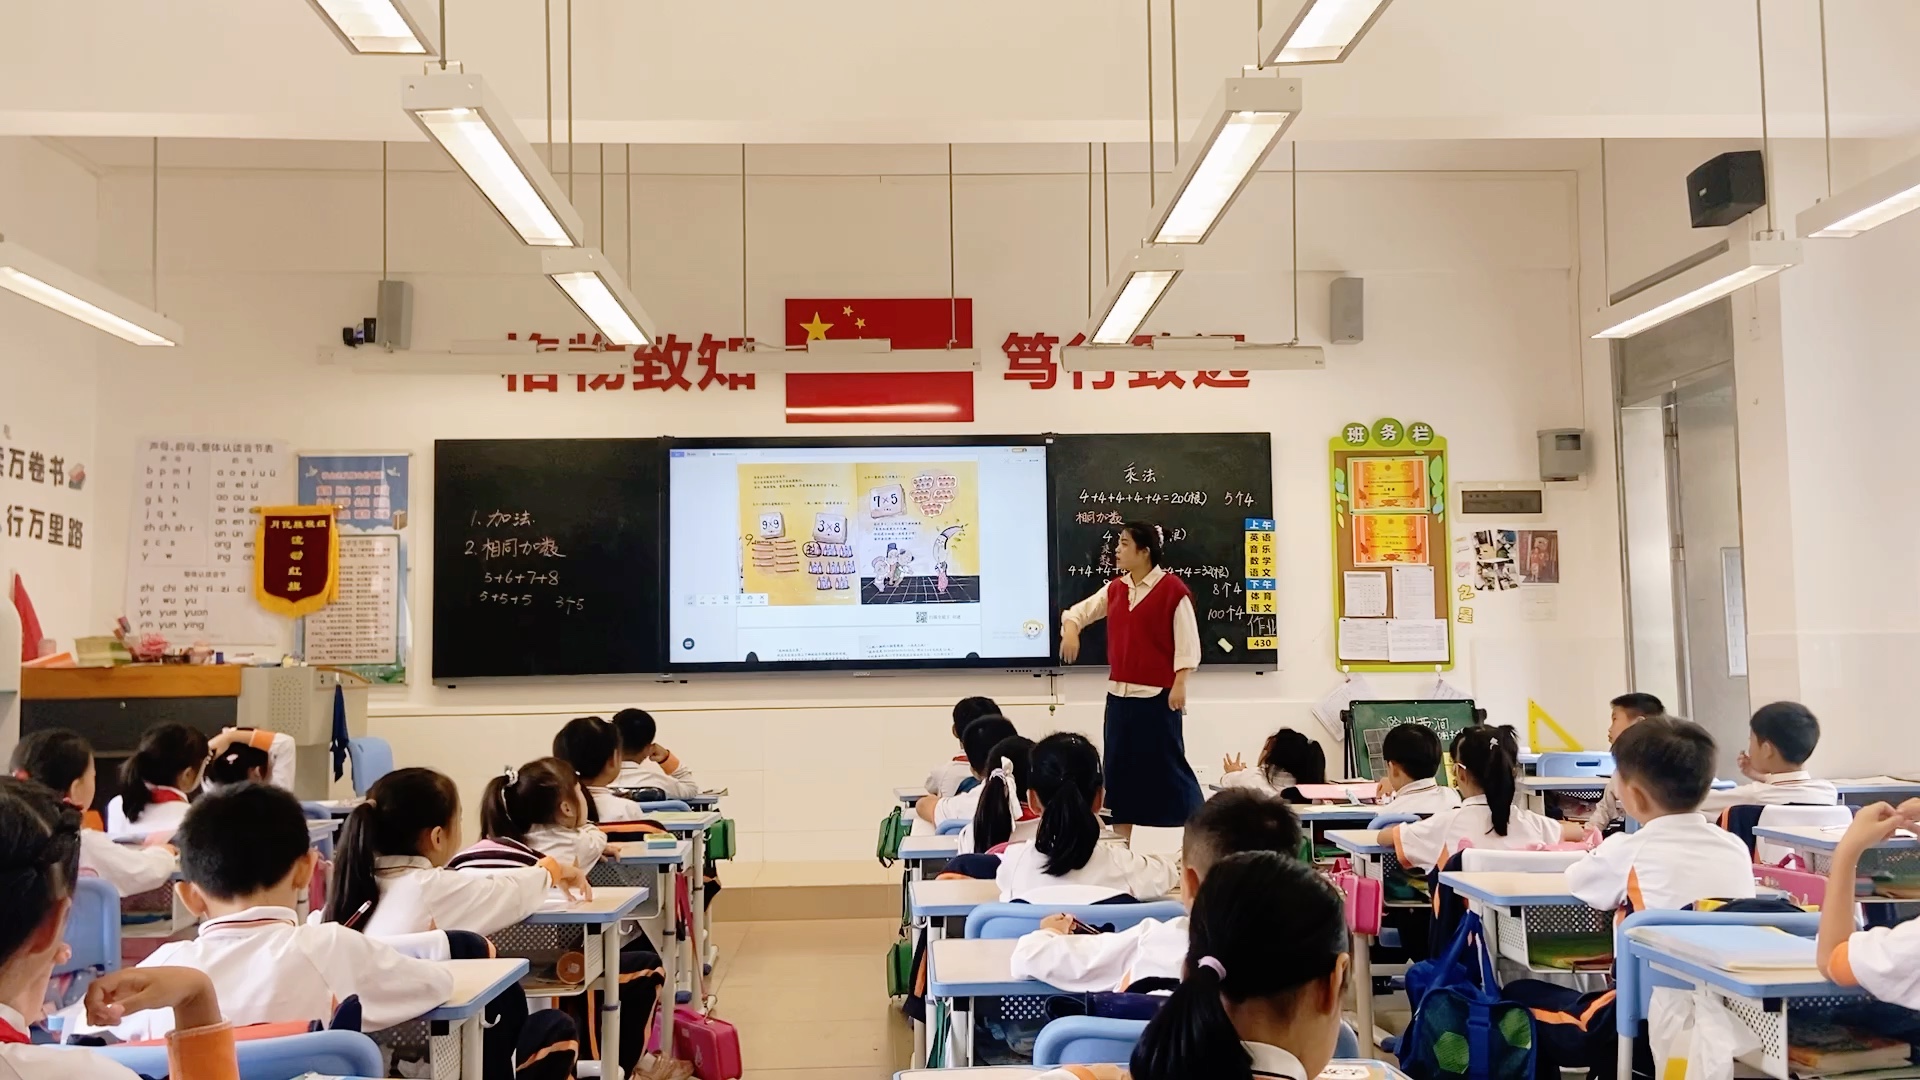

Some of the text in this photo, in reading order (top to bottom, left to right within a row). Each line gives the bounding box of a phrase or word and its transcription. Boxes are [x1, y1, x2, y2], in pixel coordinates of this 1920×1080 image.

[1347, 423, 1430, 443] 班务栏
[1123, 461, 1157, 484] 乘法
[1075, 510, 1125, 525] 相同加数
[7, 504, 83, 550] 行万里路
[1250, 520, 1272, 530] 上午
[1250, 533, 1271, 542] 英语
[1250, 545, 1271, 554] 音乐
[1250, 556, 1271, 565] 数学
[485, 569, 560, 586] 5+6+7+8
[1250, 568, 1271, 577] 语文
[1250, 579, 1272, 589] 下午
[479, 591, 532, 606] 5+5+5
[1250, 591, 1272, 601] 体育
[1250, 603, 1272, 613] 语文
[1207, 605, 1245, 622] 100个4
[1254, 639, 1272, 647] 430
